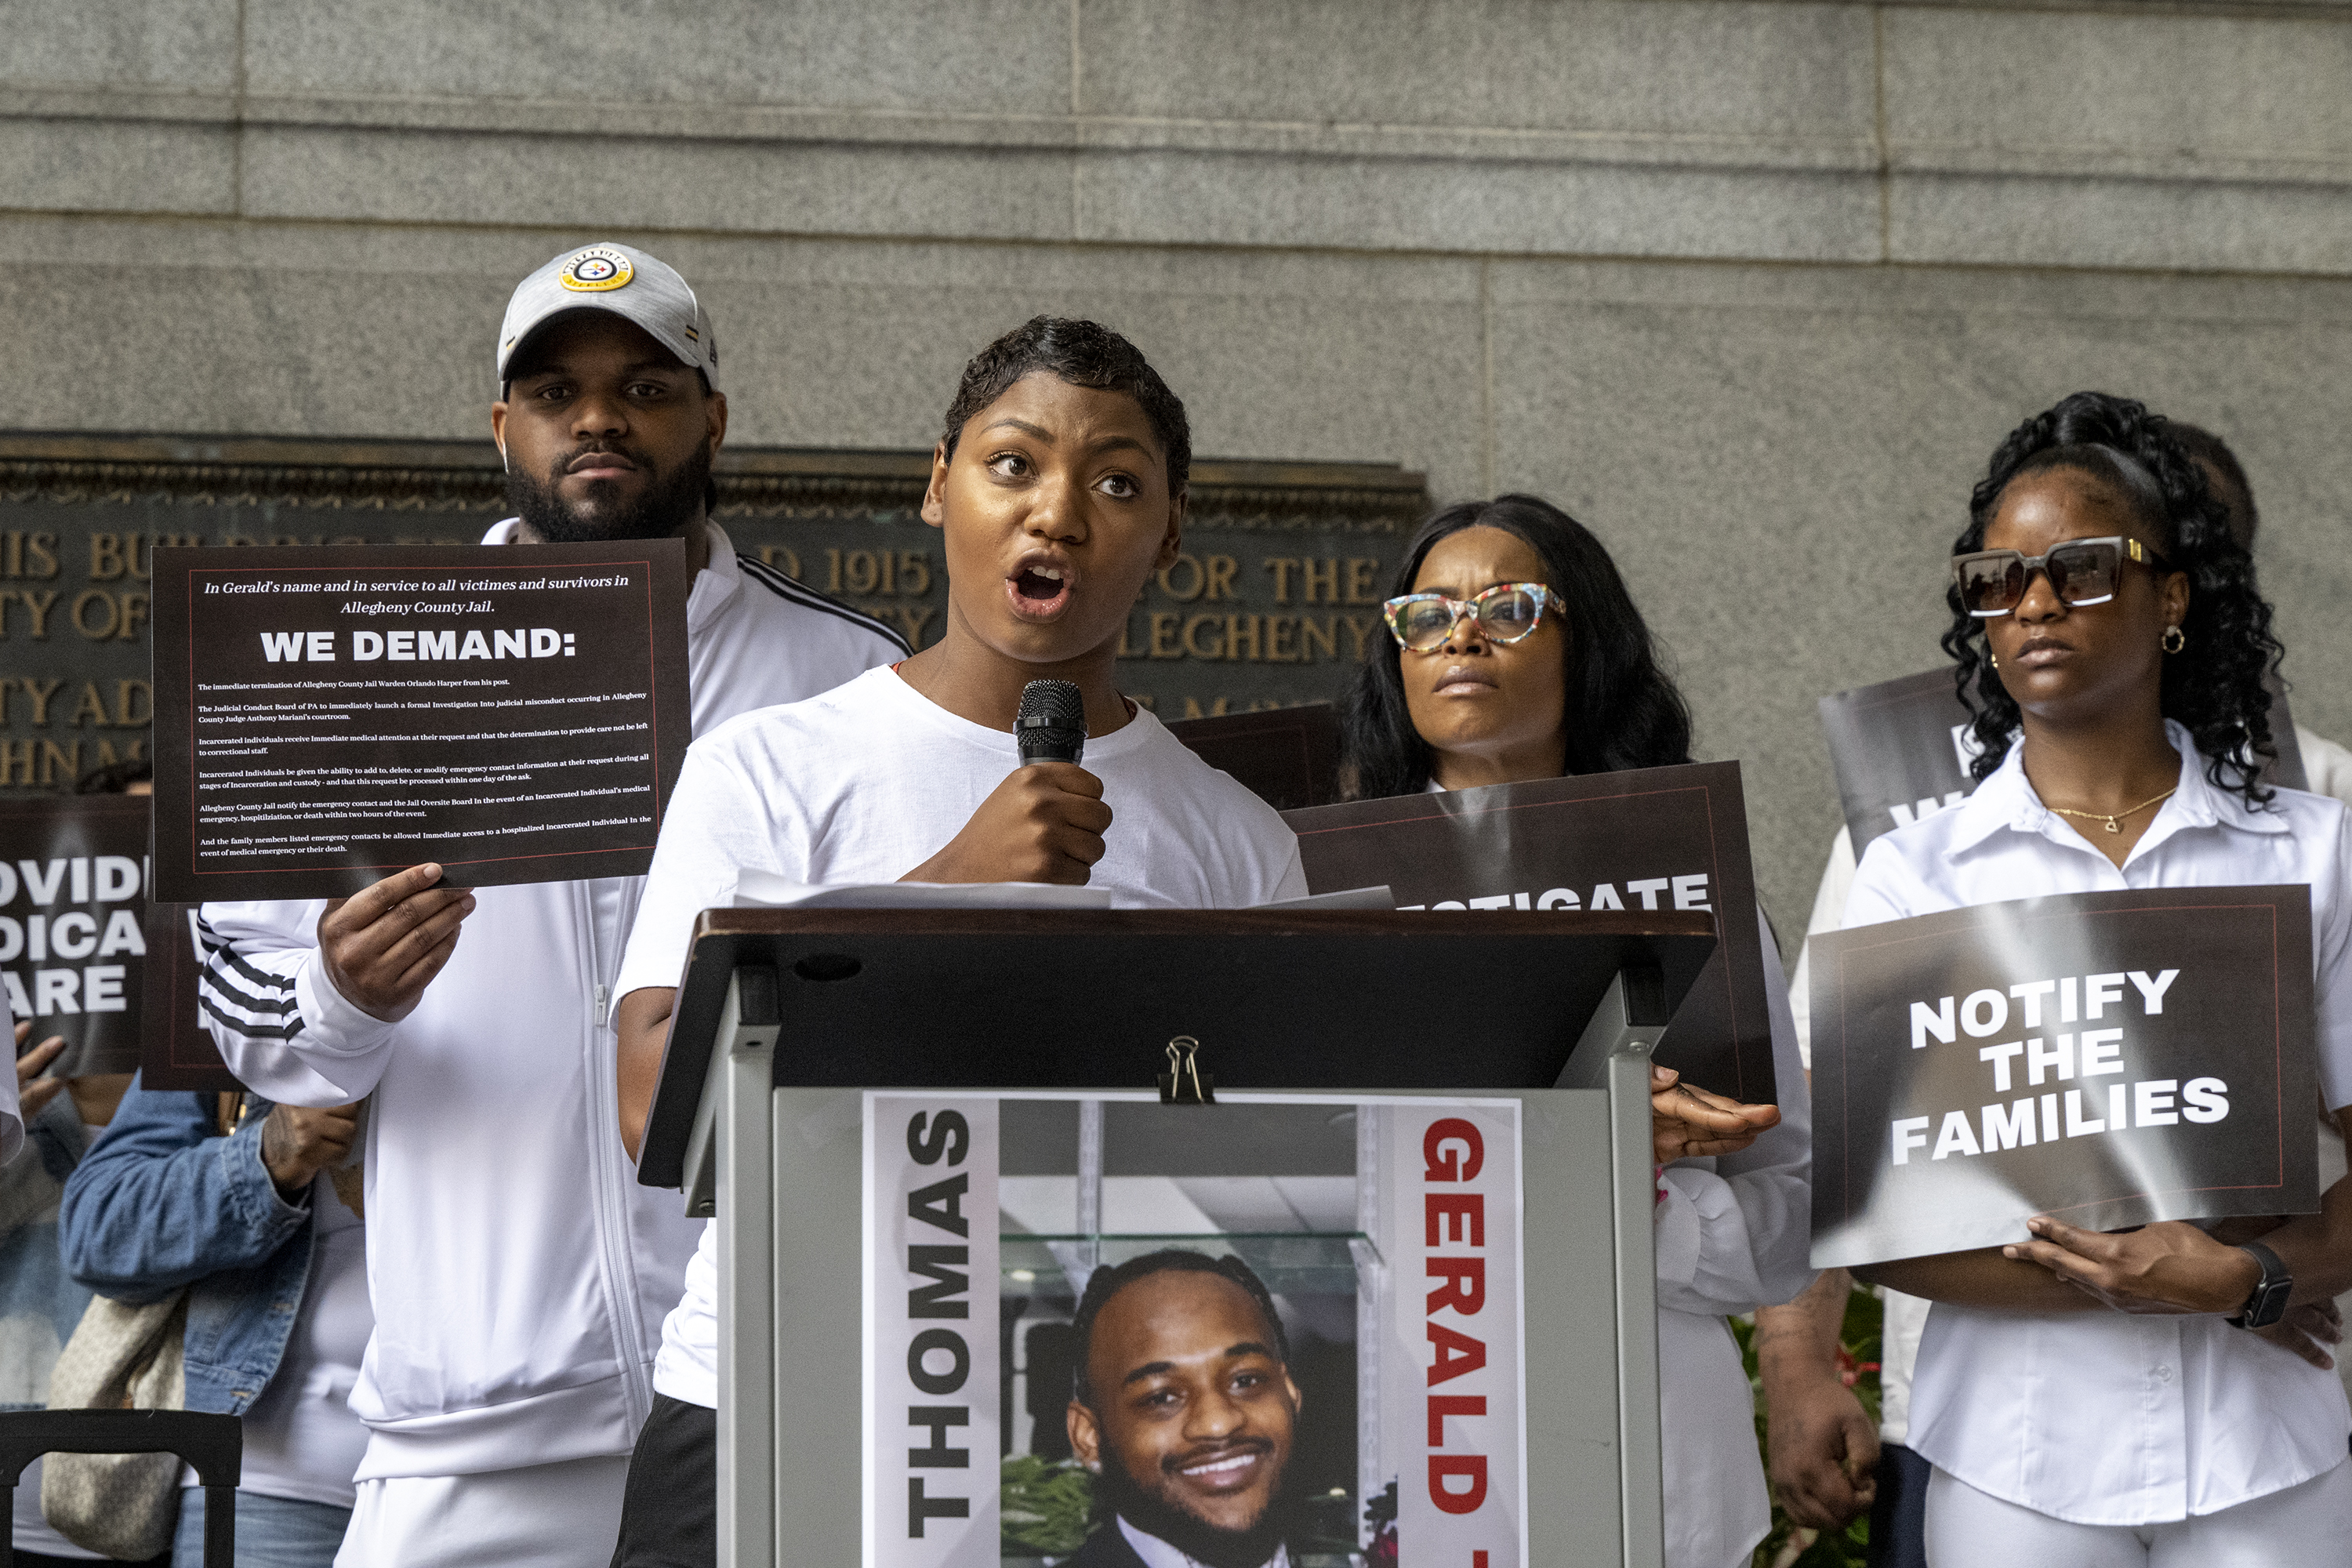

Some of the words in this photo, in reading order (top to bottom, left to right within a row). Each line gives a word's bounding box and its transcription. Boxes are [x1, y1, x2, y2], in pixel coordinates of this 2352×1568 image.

[8, 530, 58, 576] IS
[827, 548, 930, 593] 1915
[1156, 552, 1240, 601] OR
[1265, 557, 1380, 603] THE
[204, 583, 218, 593] In
[222, 581, 278, 593] Gerald's
[282, 583, 320, 592] name
[323, 580, 348, 591] and
[352, 580, 366, 591] in
[369, 579, 418, 591] service
[421, 581, 434, 591] to
[437, 579, 454, 590] all
[459, 579, 516, 590] victimes
[518, 578, 544, 589] and
[548, 576, 611, 588] survivors
[614, 575, 627, 586] in
[71, 589, 151, 638] OF
[340, 602, 412, 615] Allegheny
[414, 601, 466, 615] County
[466, 601, 495, 613] Jail.
[260, 631, 335, 662] WE
[353, 628, 575, 660] DEMAND:
[496, 699, 522, 708] judicial
[510, 729, 559, 738] determination
[569, 726, 596, 735] provide
[207, 747, 249, 756] correctional
[408, 777, 443, 786] processed
[535, 790, 579, 800] Incarcerated
[622, 784, 650, 793] medical
[230, 837, 252, 845] family
[502, 824, 544, 834] hospitalized
[592, 817, 627, 826] Individual
[0, 855, 150, 906] OVID
[1911, 969, 2180, 1049] NOTIFY
[1980, 1028, 2124, 1092] THE
[1892, 1077, 2230, 1166] FAMILIES
[907, 1109, 971, 1538] THOMAS
[1423, 1118, 1488, 1515] GERALD
